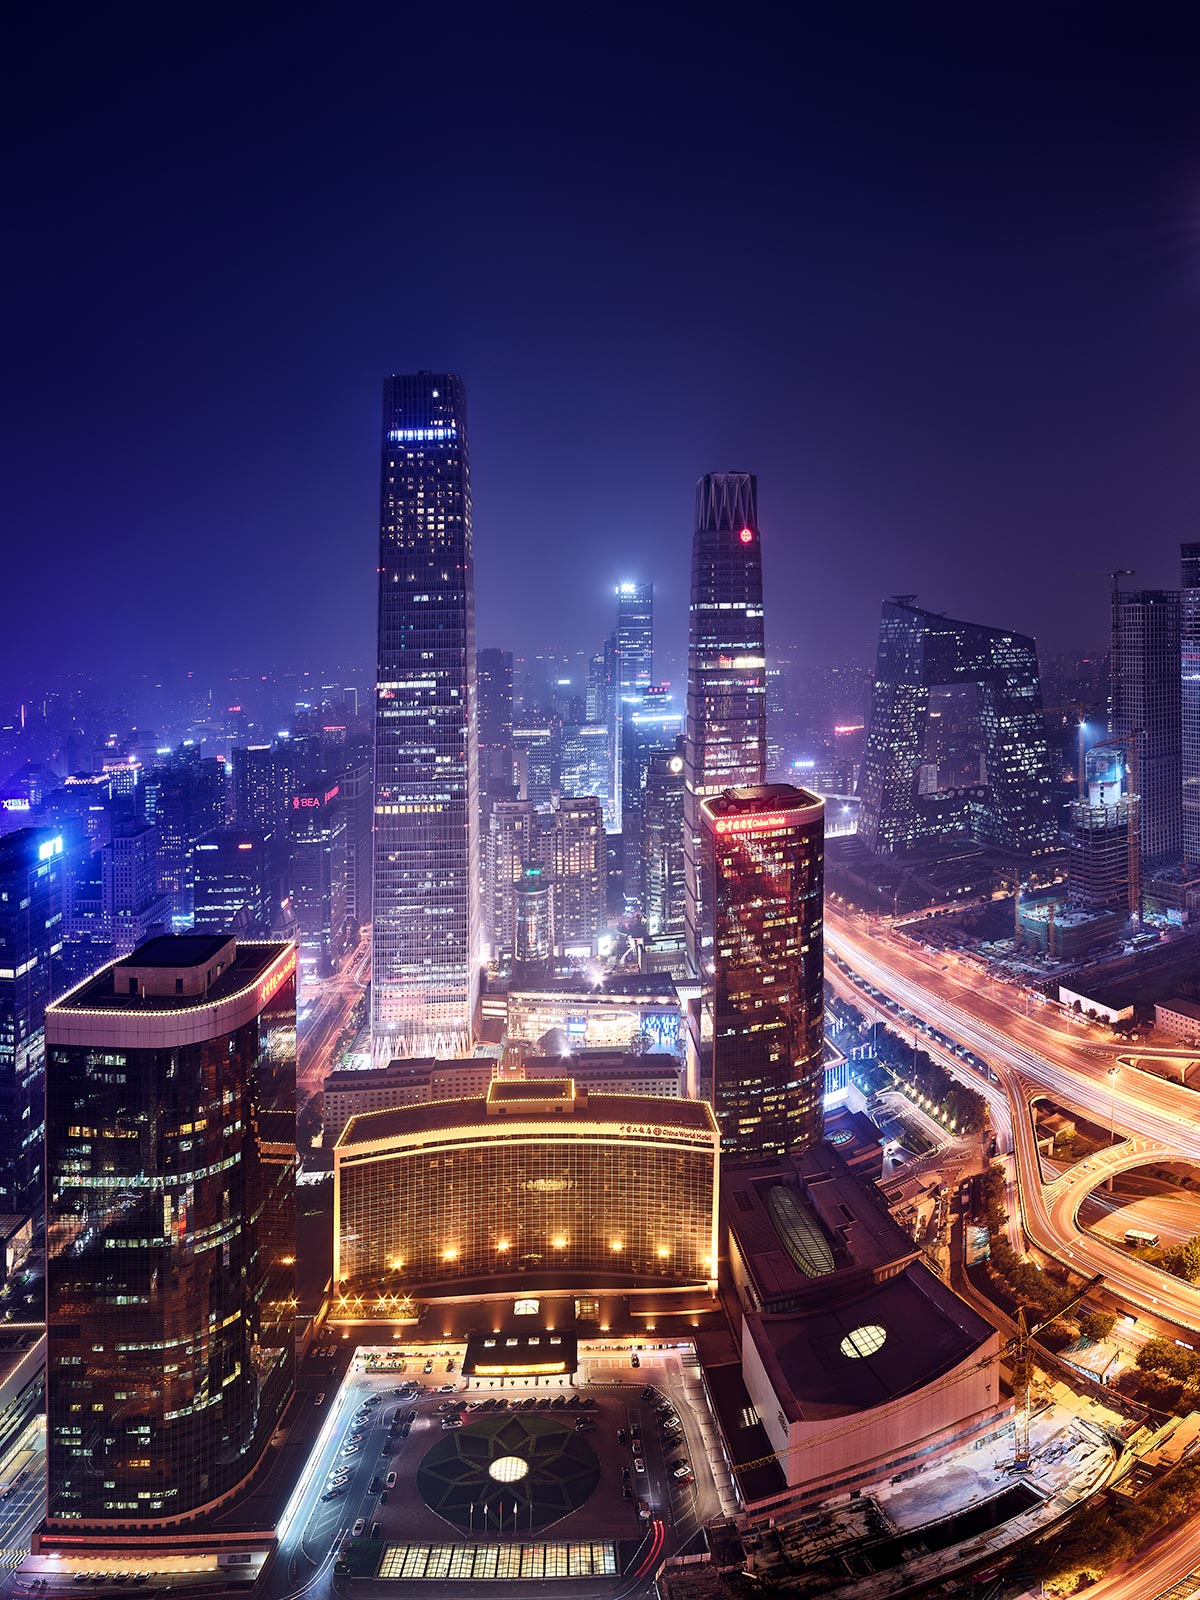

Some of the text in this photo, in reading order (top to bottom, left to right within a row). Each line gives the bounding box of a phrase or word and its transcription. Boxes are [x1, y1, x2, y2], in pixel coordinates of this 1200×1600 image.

[301, 798, 320, 807] BEA
[752, 820, 769, 828] China
[769, 817, 785, 825] World
[662, 1129, 679, 1137] China
[679, 1131, 696, 1140] World
[696, 1134, 712, 1142] Hotel
